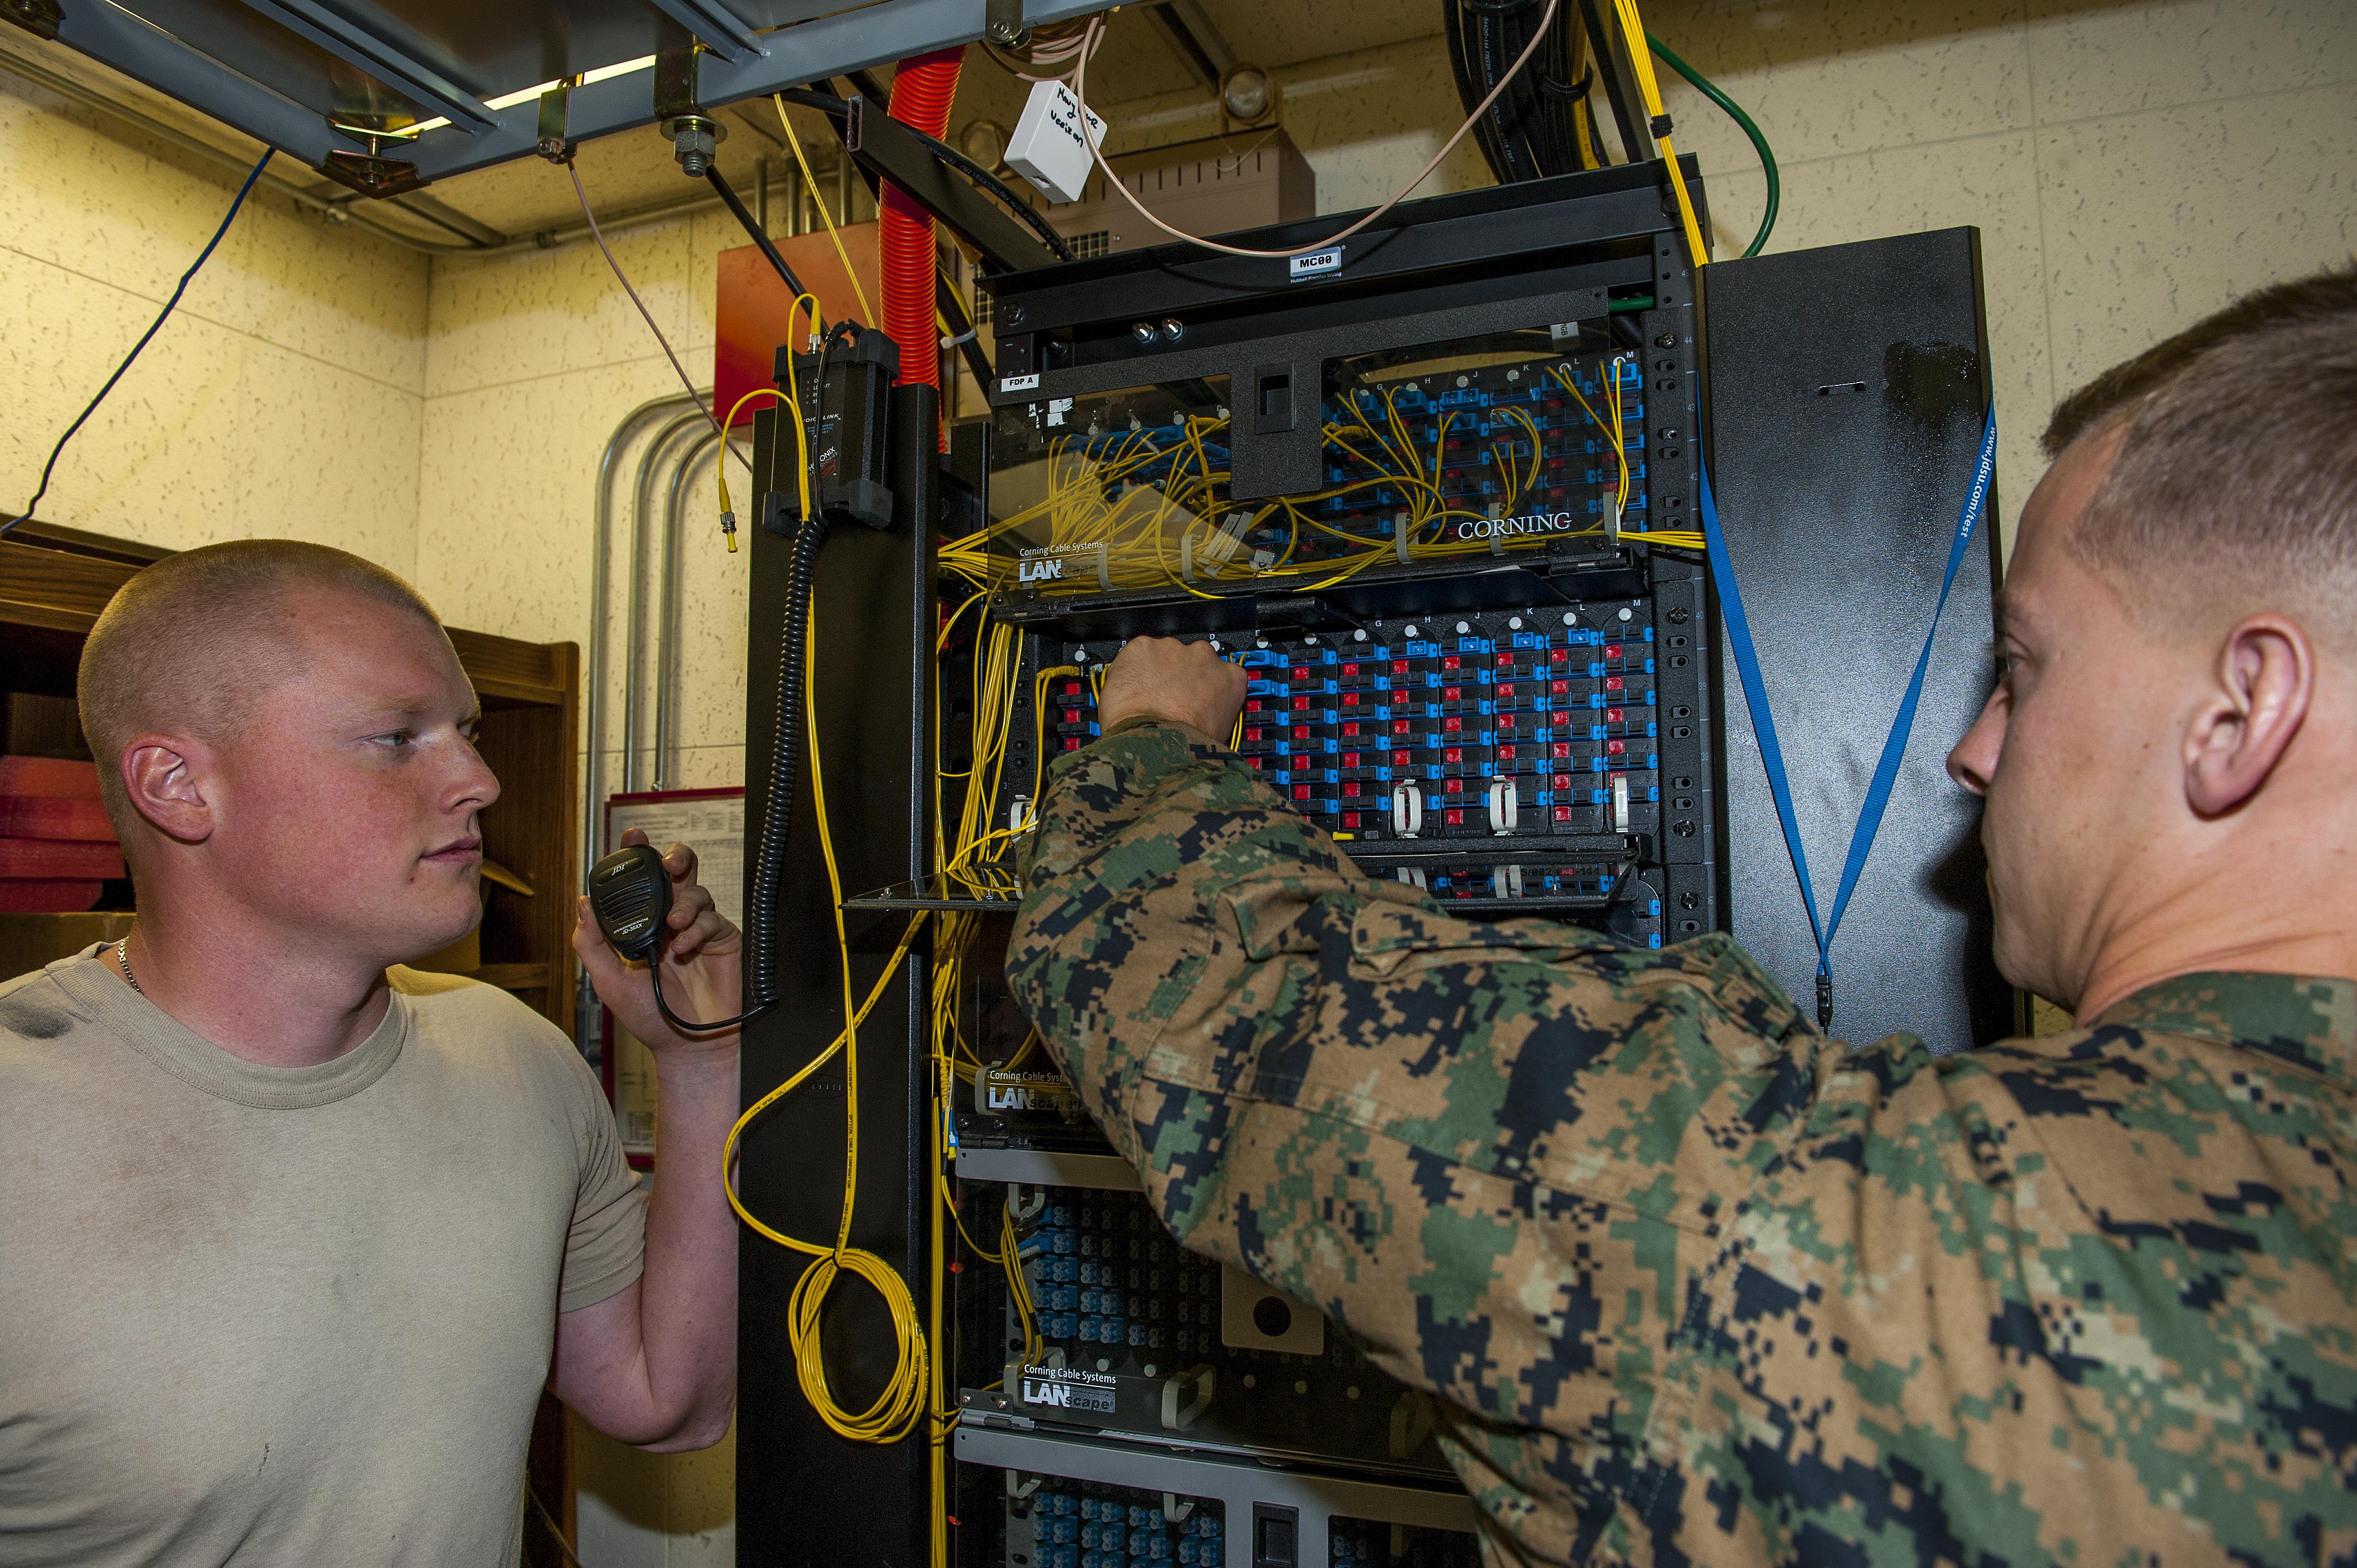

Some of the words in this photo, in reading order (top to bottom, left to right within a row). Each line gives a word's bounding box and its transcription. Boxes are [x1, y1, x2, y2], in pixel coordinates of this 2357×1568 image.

[1684, 336, 1693, 344] 44
[1010, 378, 1025, 386] FDP
[1687, 403, 1696, 411] 43
[1690, 472, 1699, 481] 42
[1960, 427, 1996, 538] www.jdsu.com/test
[1458, 512, 1572, 539] CORNING
[1020, 546, 1048, 556] Corning
[1050, 543, 1071, 553] Cable
[1073, 541, 1103, 553] Systems
[1696, 611, 1704, 620] 40
[1700, 752, 1708, 761] 38
[1703, 824, 1711, 833] 37
[611, 863, 625, 876] JDI
[989, 1070, 1021, 1082] Corning
[1022, 1071, 1044, 1081] Cable
[1046, 1072, 1068, 1084] Syst
[1024, 1364, 1056, 1379] Corning
[1058, 1368, 1080, 1379] Cable
[1082, 1371, 1116, 1384] Systems
[1024, 1380, 1110, 1410] LANscape
